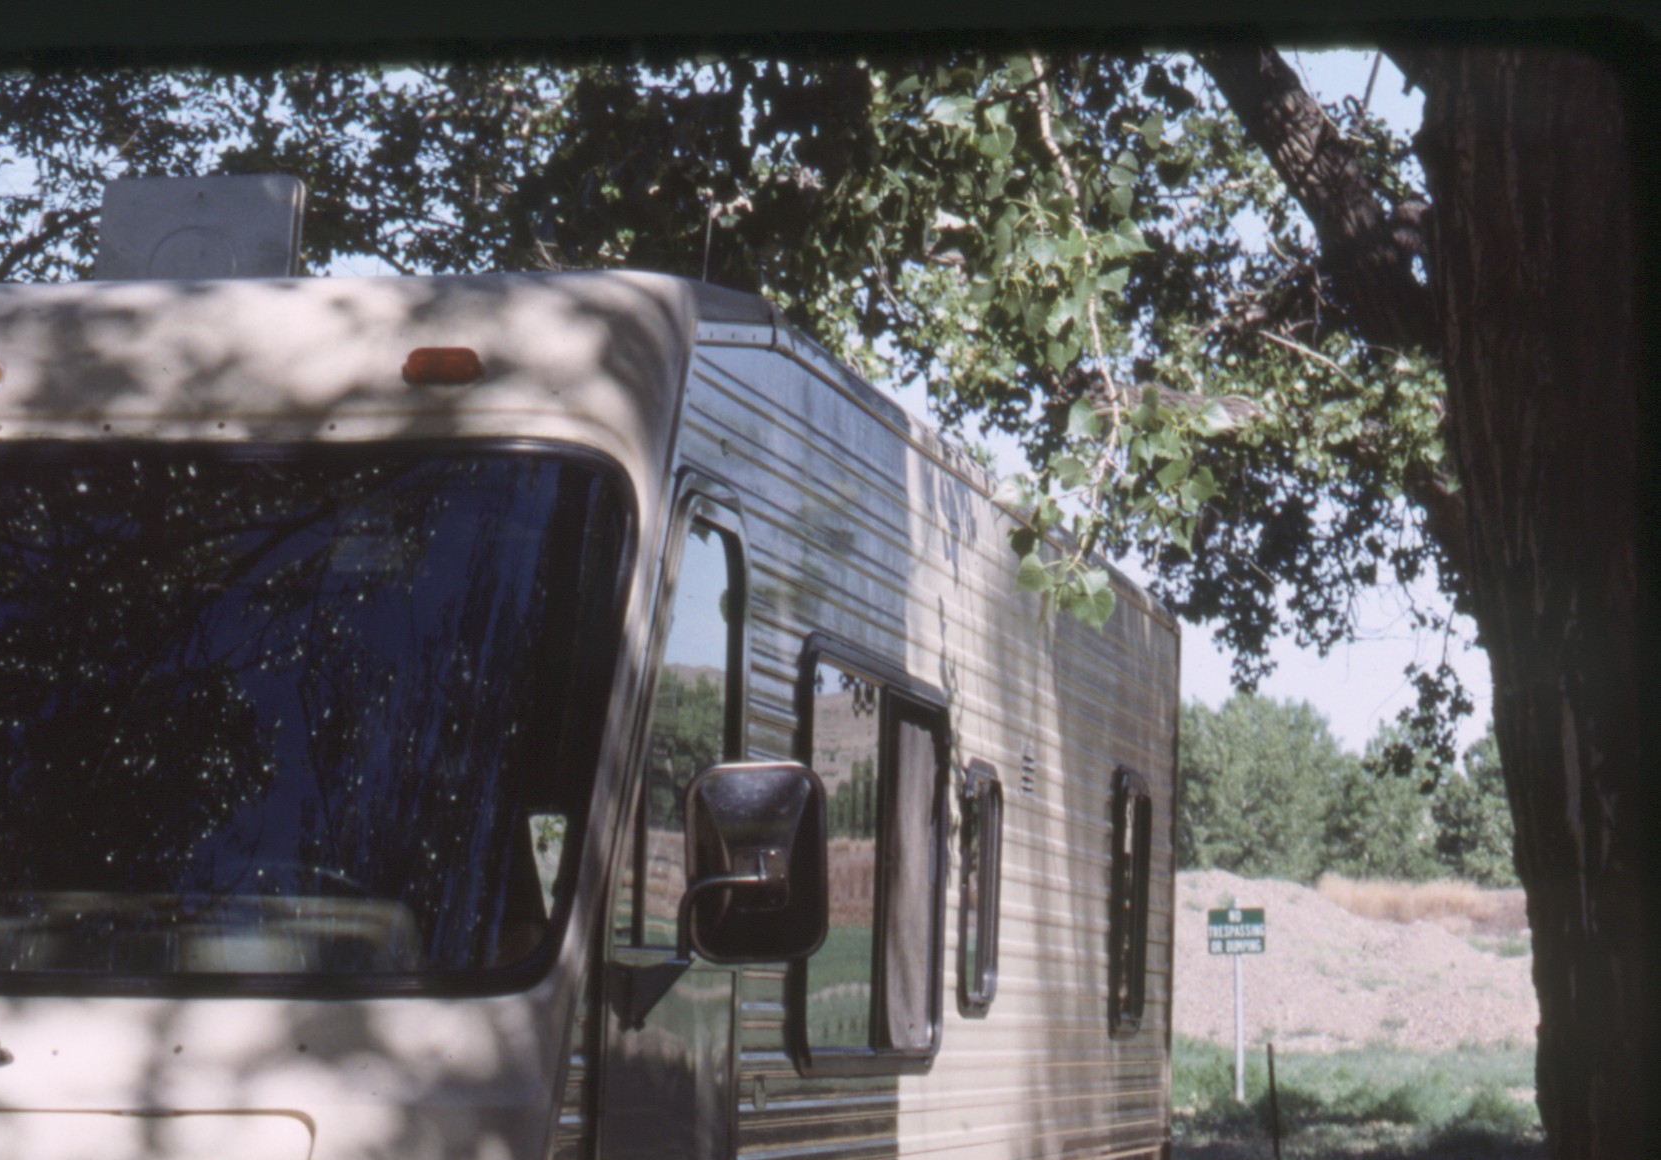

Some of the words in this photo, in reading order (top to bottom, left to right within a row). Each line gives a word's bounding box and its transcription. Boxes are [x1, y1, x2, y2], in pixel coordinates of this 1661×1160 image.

[1228, 910, 1242, 922] NO
[1208, 924, 1266, 937] TRESPASSING
[1211, 940, 1223, 953] OR
[1225, 939, 1262, 953] DUMPING
